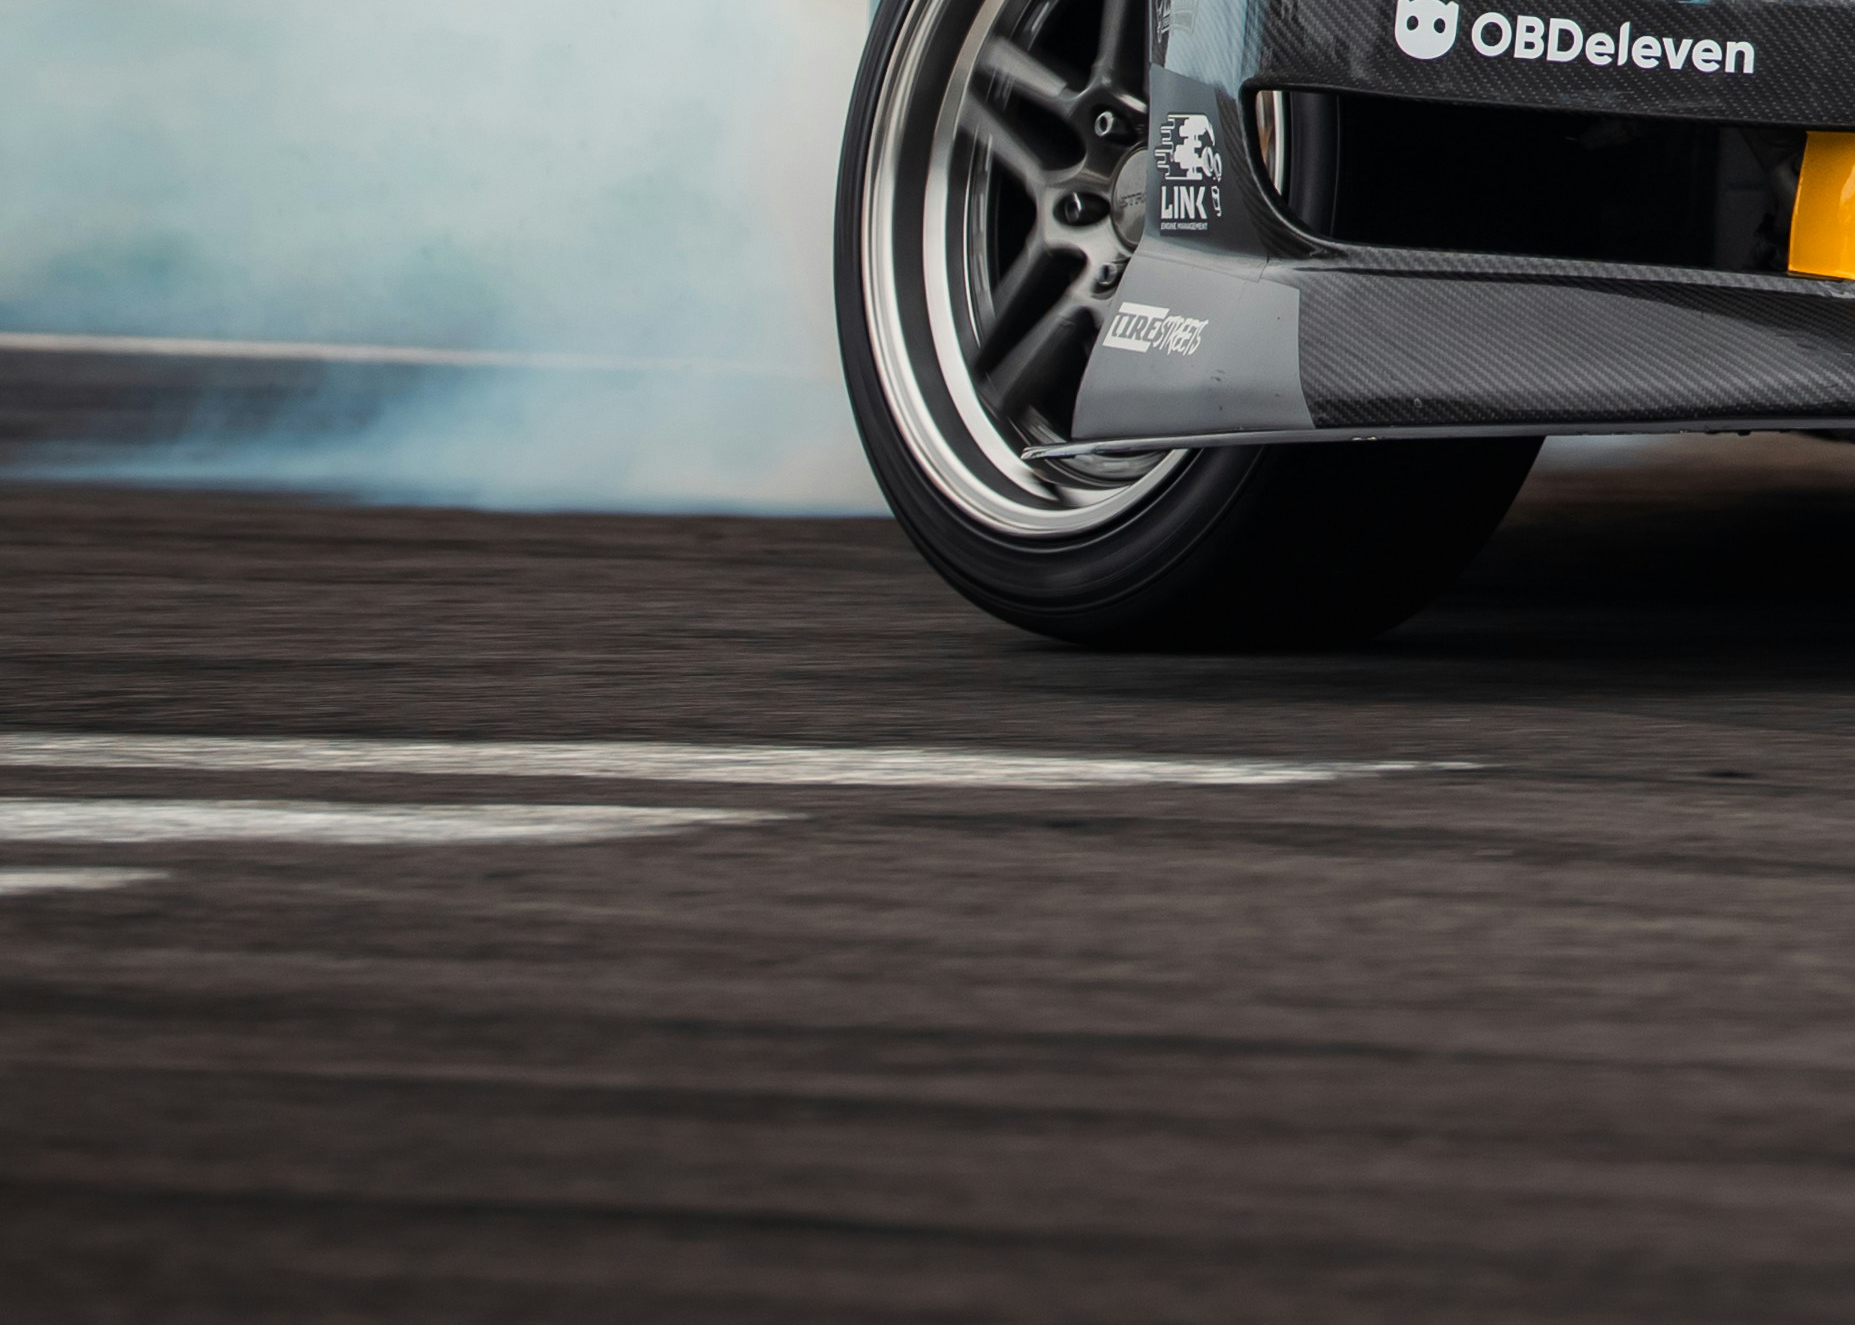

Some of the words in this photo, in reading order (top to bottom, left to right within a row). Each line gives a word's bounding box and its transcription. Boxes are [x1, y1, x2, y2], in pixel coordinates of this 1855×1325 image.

[1471, 11, 1755, 74] OBDeleven
[1160, 185, 1208, 219] LINK
[1153, 314, 1209, 356] STREETS
